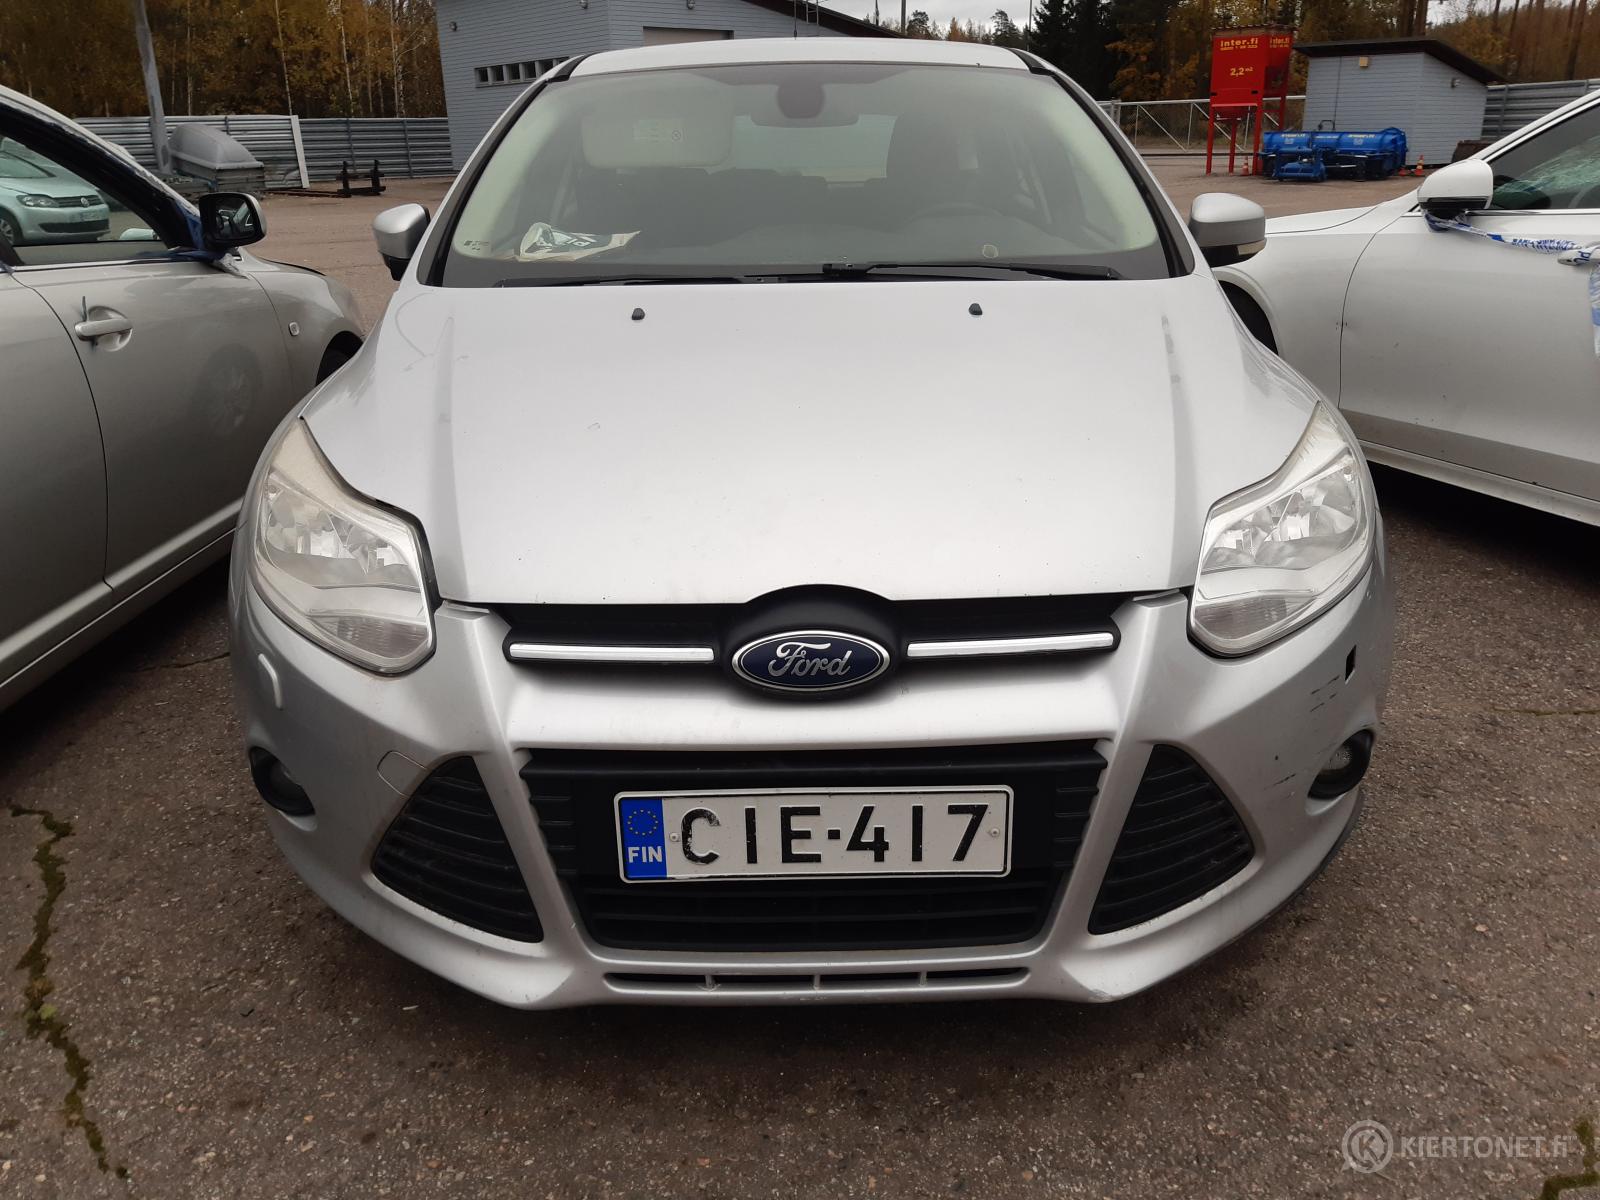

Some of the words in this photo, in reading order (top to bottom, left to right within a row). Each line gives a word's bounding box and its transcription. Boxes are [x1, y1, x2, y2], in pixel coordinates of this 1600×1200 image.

[768, 641, 852, 676] Ford
[681, 803, 989, 865] CIE-417
[627, 845, 663, 863] FIN
